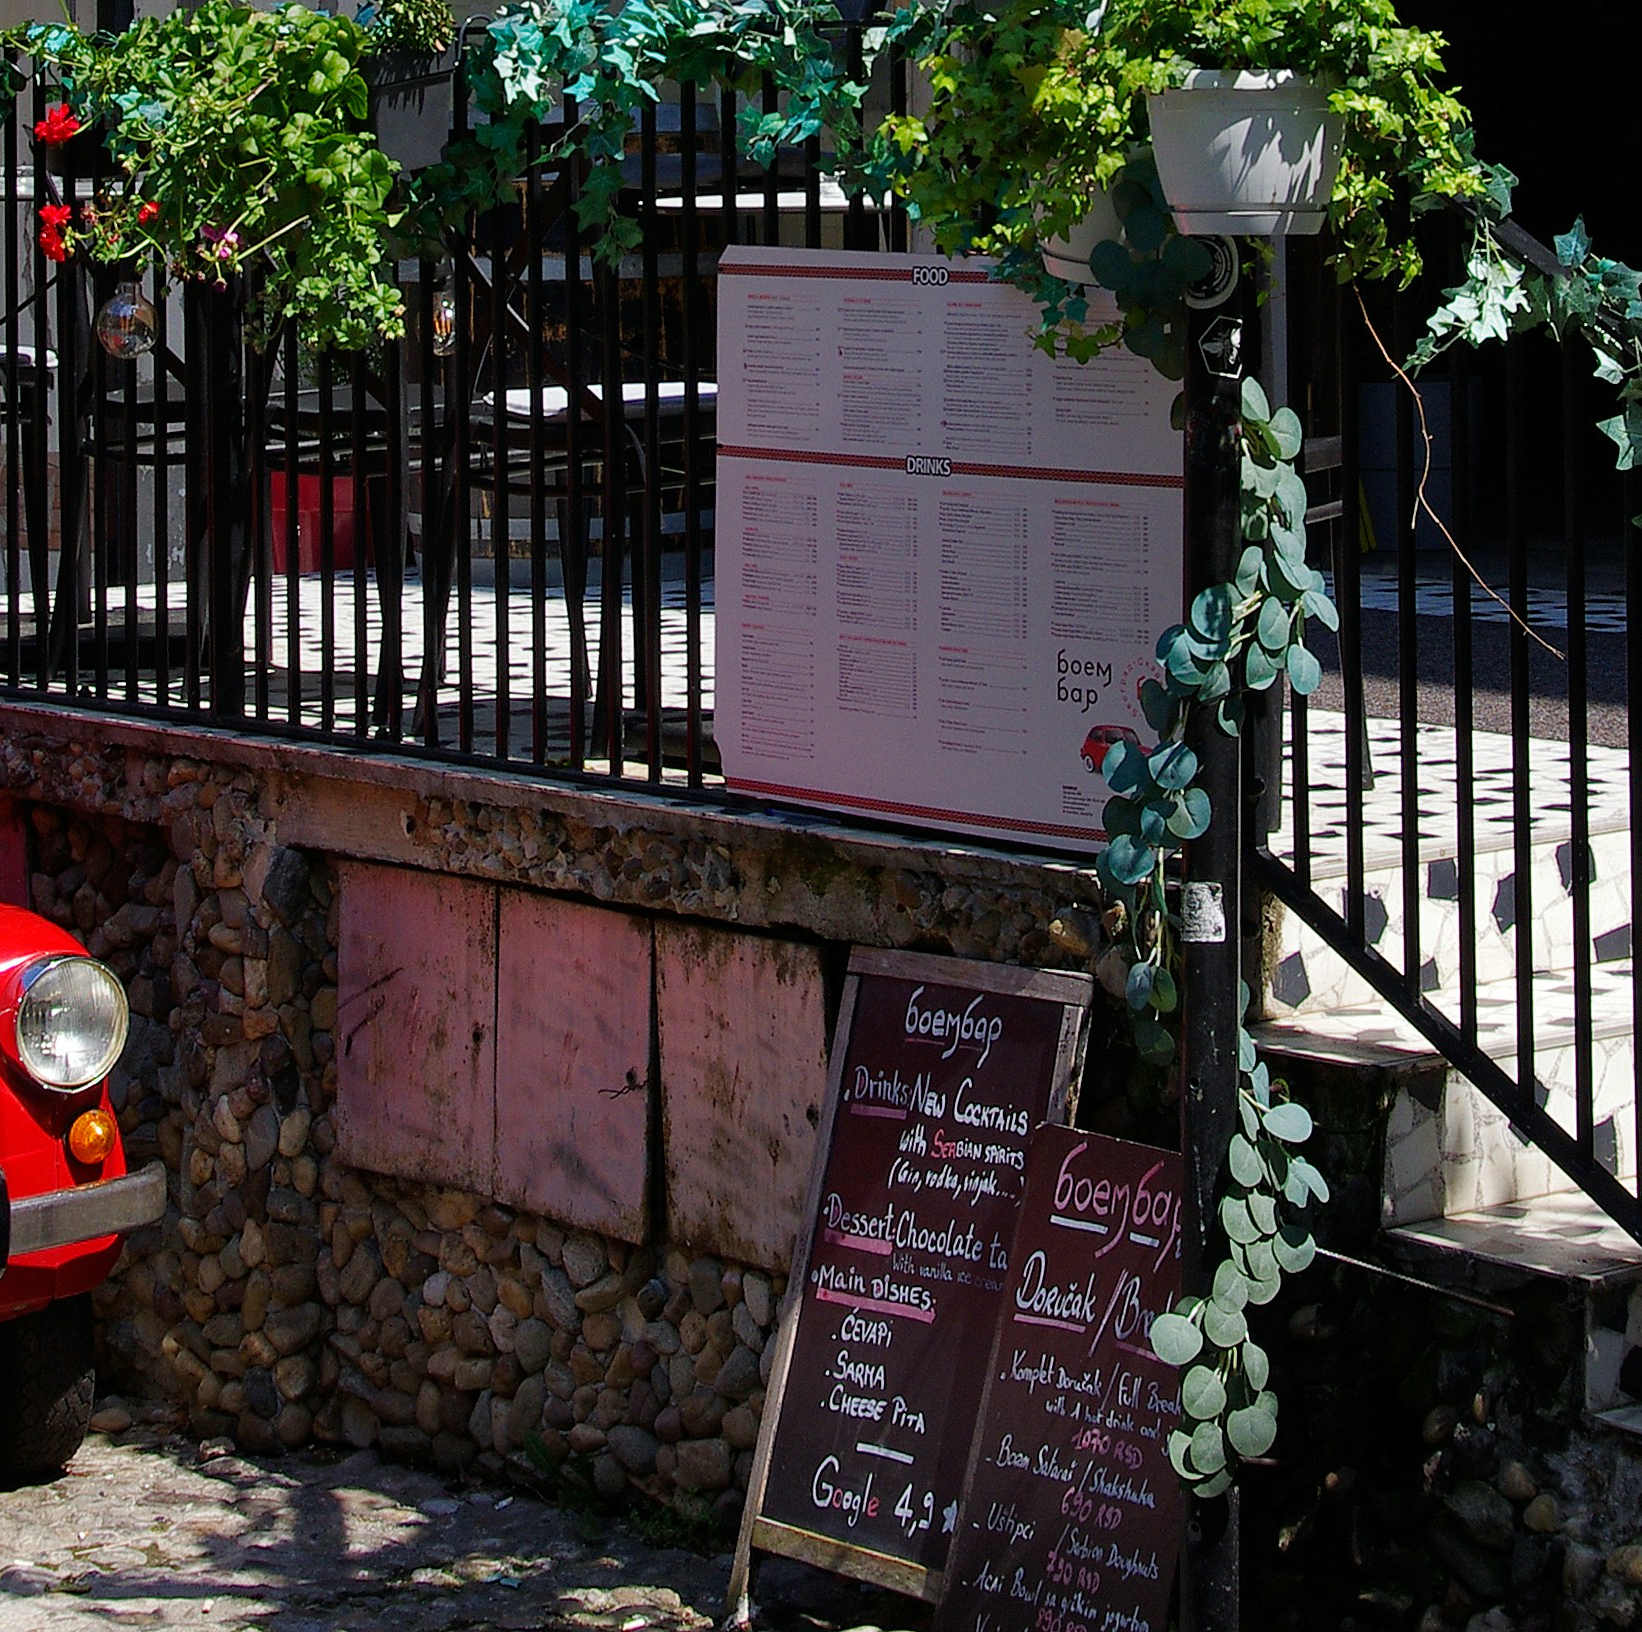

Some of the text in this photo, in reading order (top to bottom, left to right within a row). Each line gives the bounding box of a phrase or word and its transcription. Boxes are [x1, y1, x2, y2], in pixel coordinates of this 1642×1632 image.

[912, 267, 948, 285] FOOD
[907, 457, 951, 475] DRINKS
[1057, 648, 1112, 688] боем
[1057, 677, 1098, 714] бар
[898, 1122, 928, 1158] with
[895, 1209, 984, 1262] Chocolate
[817, 1264, 867, 1294] Main
[1113, 1440, 1144, 1470] RSD
[811, 1455, 882, 1528] Google
[1095, 1503, 1123, 1531] RSD
